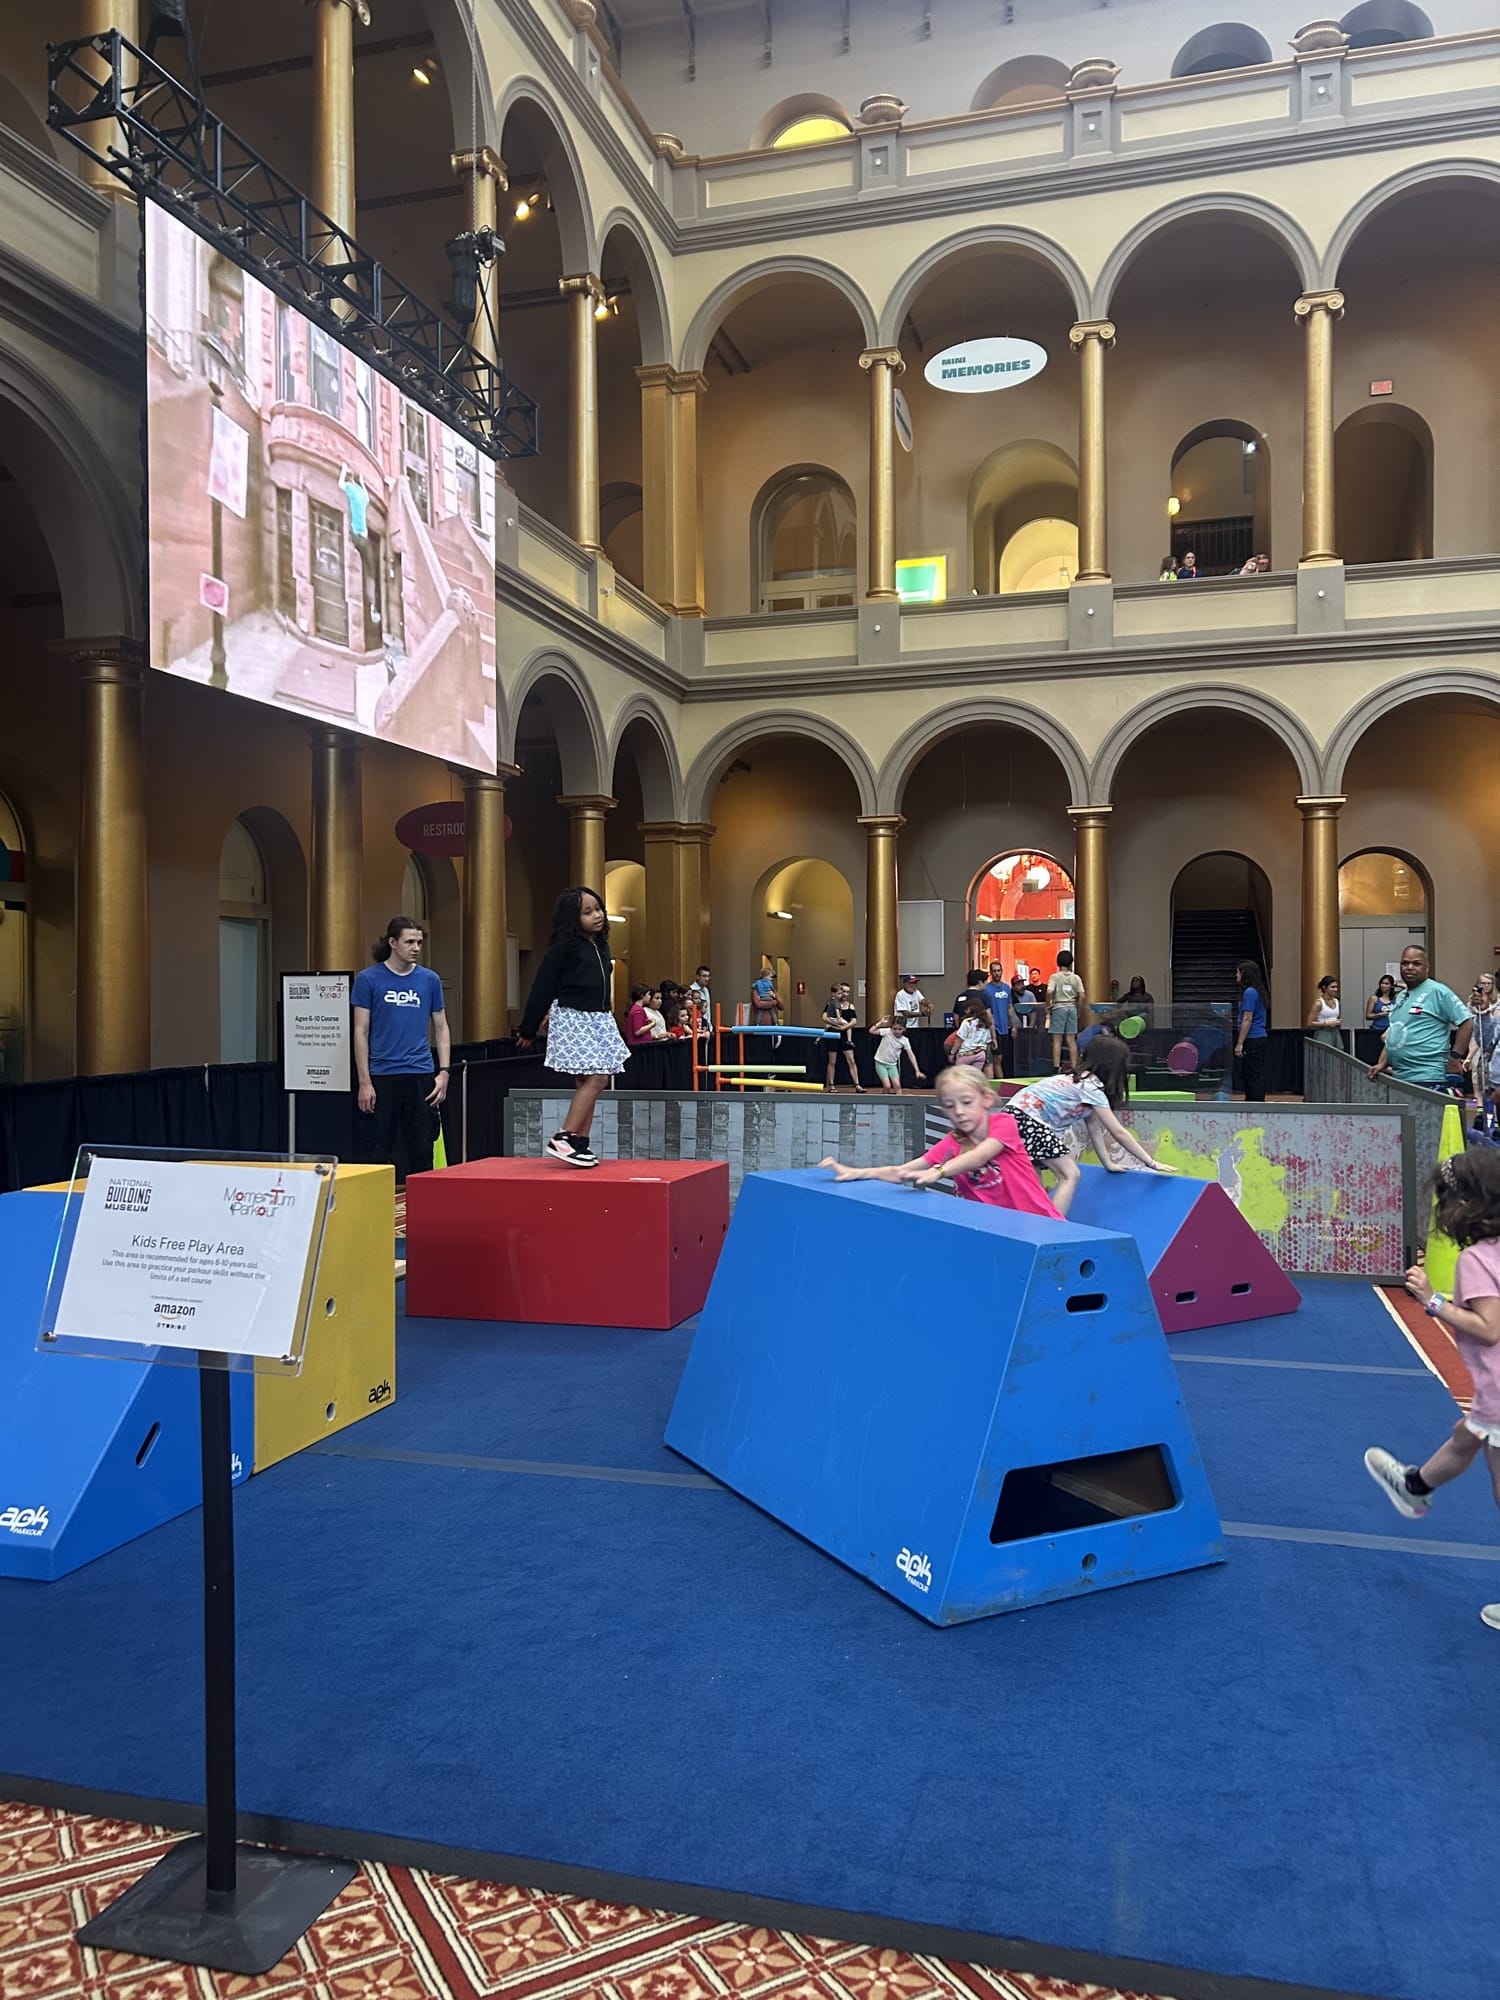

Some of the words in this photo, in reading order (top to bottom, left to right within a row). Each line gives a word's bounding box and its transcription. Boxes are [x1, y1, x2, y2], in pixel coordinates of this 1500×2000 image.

[941, 356, 966, 366] MINI
[941, 359, 1031, 379] MEMORIES
[423, 822, 465, 836] RESTROO
[384, 990, 420, 1006] apk
[295, 1015, 308, 1023] Ages
[109, 1178, 152, 1188] NATIONAL
[106, 1186, 152, 1204] BUILDING
[104, 1203, 149, 1212] MUSEUM
[230, 1201, 278, 1217] Parkour
[132, 1235, 157, 1248] Kids
[159, 1236, 186, 1250] Free
[188, 1240, 214, 1256] Play
[216, 1242, 244, 1255] Area
[112, 1250, 124, 1258] This
[146, 1254, 188, 1263] recommended
[148, 1264, 172, 1272] practice
[212, 1268, 229, 1277] skills
[230, 1270, 254, 1279] without
[150, 1272, 167, 1280] limits
[154, 1303, 196, 1316] amazon
[368, 1379, 391, 1404] apk
[0, 1505, 49, 1531] apk
[896, 1547, 932, 1587] apk
